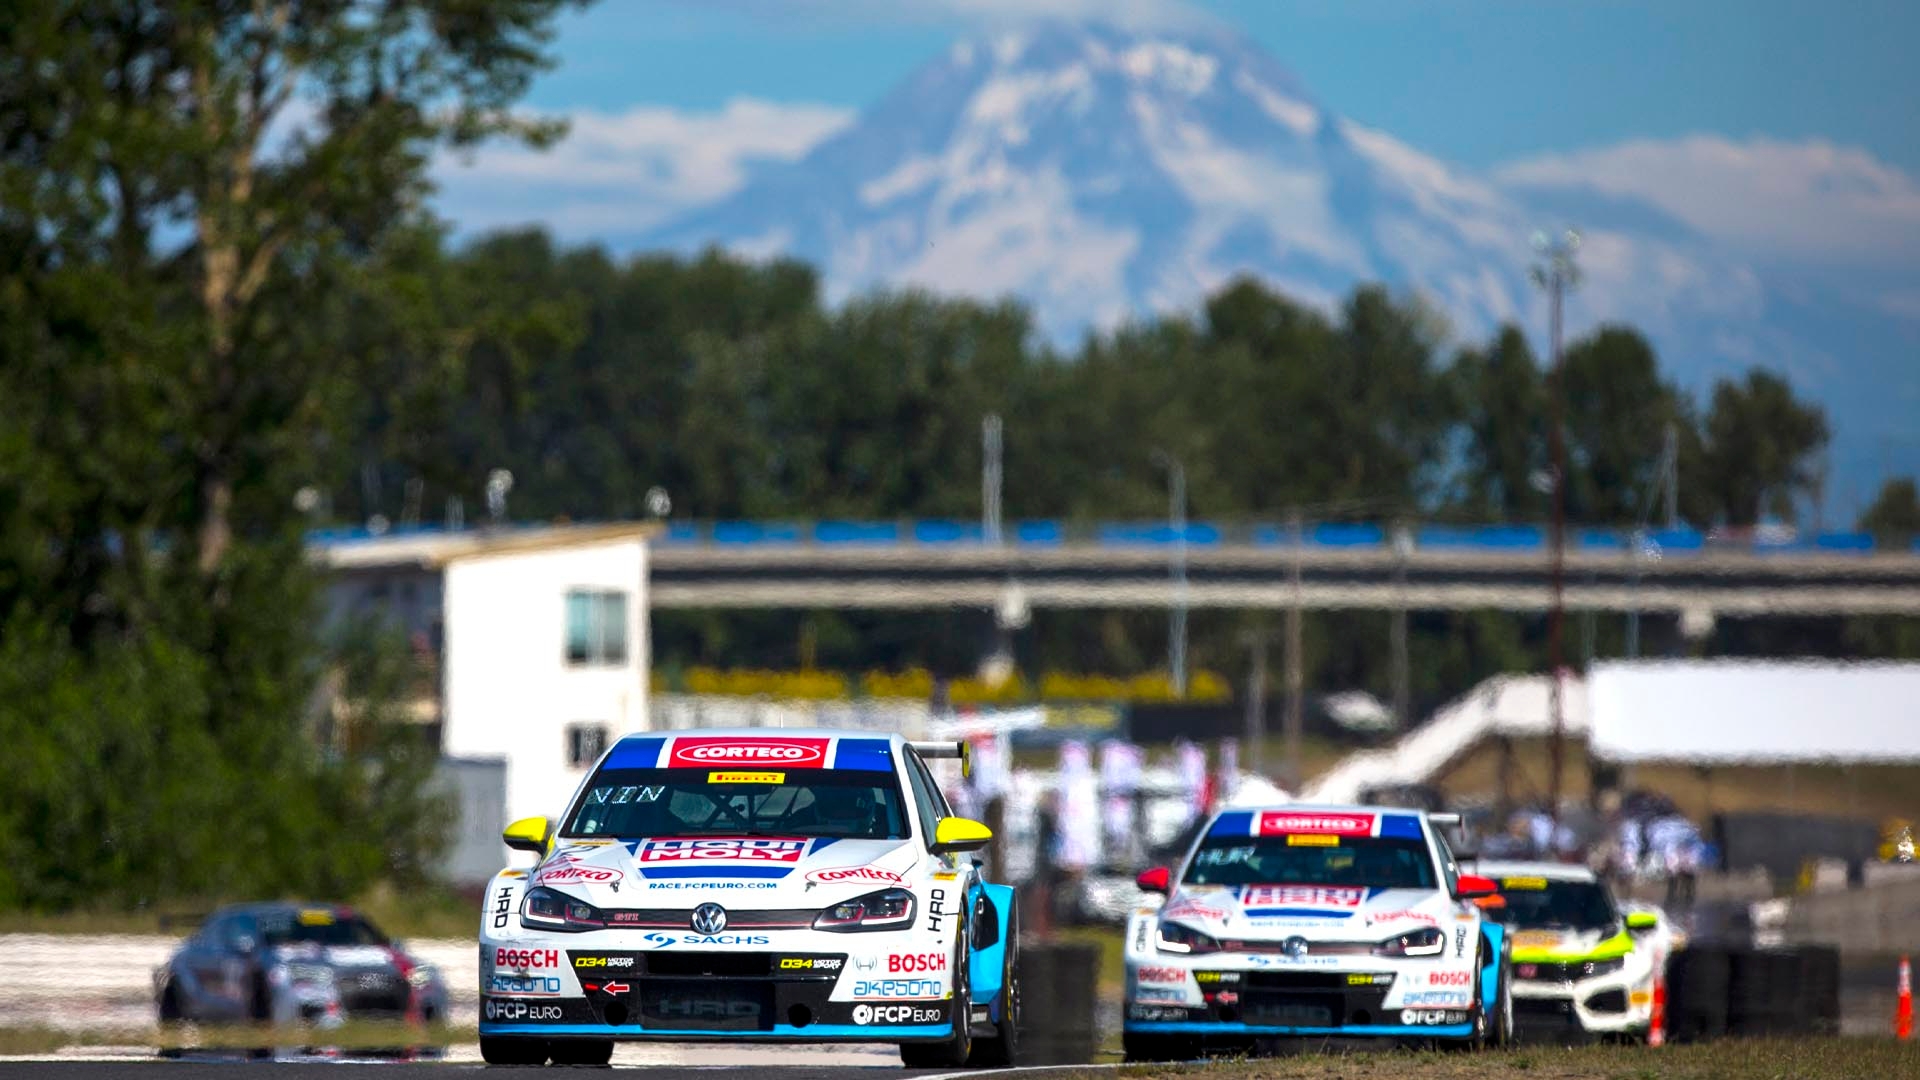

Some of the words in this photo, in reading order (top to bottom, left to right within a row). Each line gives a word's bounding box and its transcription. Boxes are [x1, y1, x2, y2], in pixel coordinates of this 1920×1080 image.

[693, 747, 804, 758] CORTECO
[1274, 818, 1357, 831] CORTECO
[648, 849, 799, 860] MOLY
[817, 868, 902, 883] CORTECO
[494, 887, 514, 929] HRD
[927, 888, 945, 932] HRD
[683, 936, 769, 945] SACHS
[495, 948, 559, 969] BOSCH
[575, 957, 607, 967] 034
[780, 959, 813, 969] 034
[888, 953, 946, 973] BOSCH
[1429, 971, 1471, 986] BOSCH
[496, 1004, 527, 1019] FCP
[530, 1007, 562, 1019] EURO
[874, 1006, 911, 1023] FCP
[913, 1009, 941, 1022] EURO
